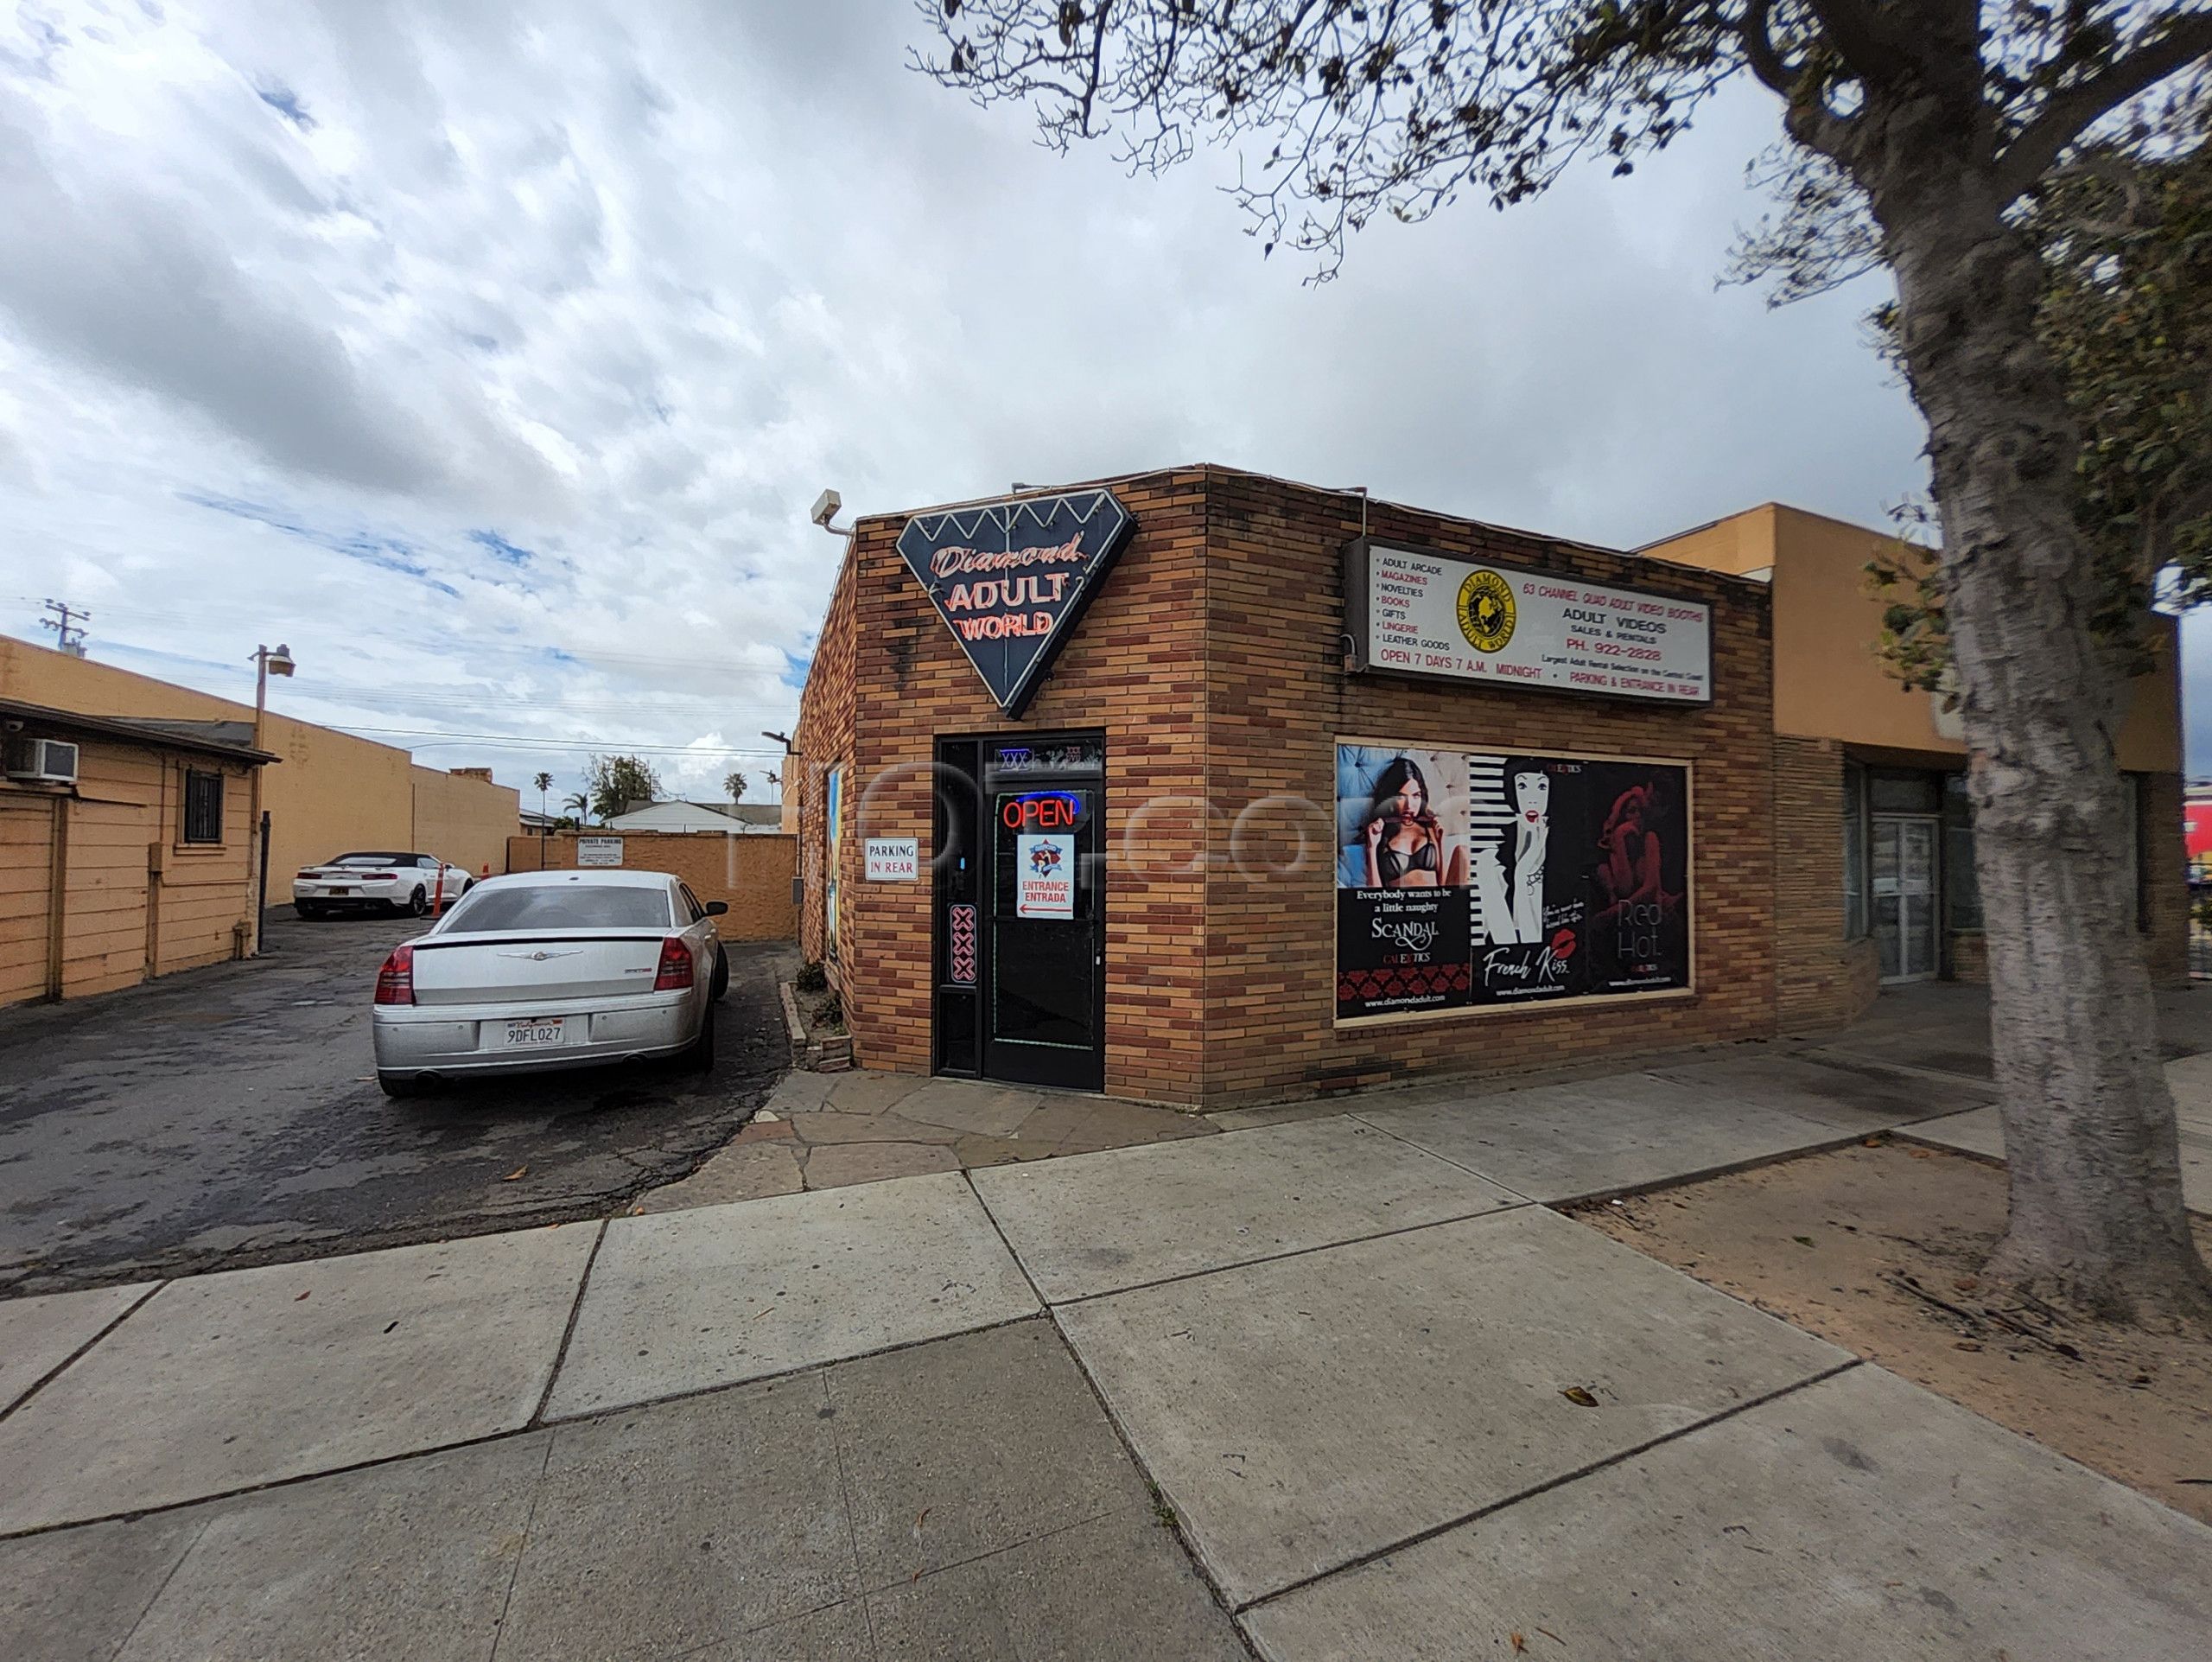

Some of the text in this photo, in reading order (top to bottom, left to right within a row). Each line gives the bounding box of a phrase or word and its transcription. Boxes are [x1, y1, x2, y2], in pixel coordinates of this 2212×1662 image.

[930, 531, 1086, 578] Diamond
[1382, 557, 1442, 576] ADULT ARCADE
[1382, 570, 1427, 585] MAGAZINES
[945, 572, 1069, 612] ADULT
[1382, 583, 1423, 597] NOVELTIES
[1464, 573, 1511, 602] DIAMOND
[1382, 595, 1410, 608] BOOKS
[1523, 583, 1535, 595] 63
[1539, 586, 1579, 602] CHANNEL
[1583, 592, 1606, 606] QUAD
[1609, 598, 1635, 610] ADULT
[1637, 602, 1664, 616] VIDEO
[1382, 608, 1406, 620] GIFTS
[1562, 608, 1667, 634] ADULT VIDEOS
[953, 611, 1053, 641] WORLD
[1382, 621, 1419, 634] LINGERIE
[1459, 615, 1513, 648] ADULT WORLD
[1382, 634, 1450, 651] LEATHER GOODS
[1571, 625, 1601, 636] SALES
[1617, 632, 1656, 644] RENTALS
[1381, 649, 1410, 664] OPEN
[1414, 653, 1421, 665] 7
[1426, 654, 1452, 668] DAYS
[1456, 659, 1463, 670] 7
[1466, 659, 1487, 672] A.M.
[1497, 663, 1542, 678] MIDNIGHT
[1570, 672, 1607, 685] PARKING
[1541, 654, 1567, 665] Largest
[1001, 752, 1027, 768] XXX
[1003, 799, 1074, 828] OPEN
[869, 845, 914, 856] PARKING
[870, 862, 913, 873] IN REAR
[1022, 881, 1069, 891] ENTRANCE
[1025, 893, 1065, 903] ENTRADA
[1357, 889, 1405, 901] Everybody
[1442, 888, 1452, 897] be
[1374, 902, 1439, 913] a little naughty
[1371, 917, 1440, 951] SCANDAL
[952, 907, 976, 980] XXX
[1483, 946, 1570, 986] French Kiss
[1364, 995, 1446, 1007] www.diamondadult.com
[506, 1028, 562, 1043] 9DFL027
